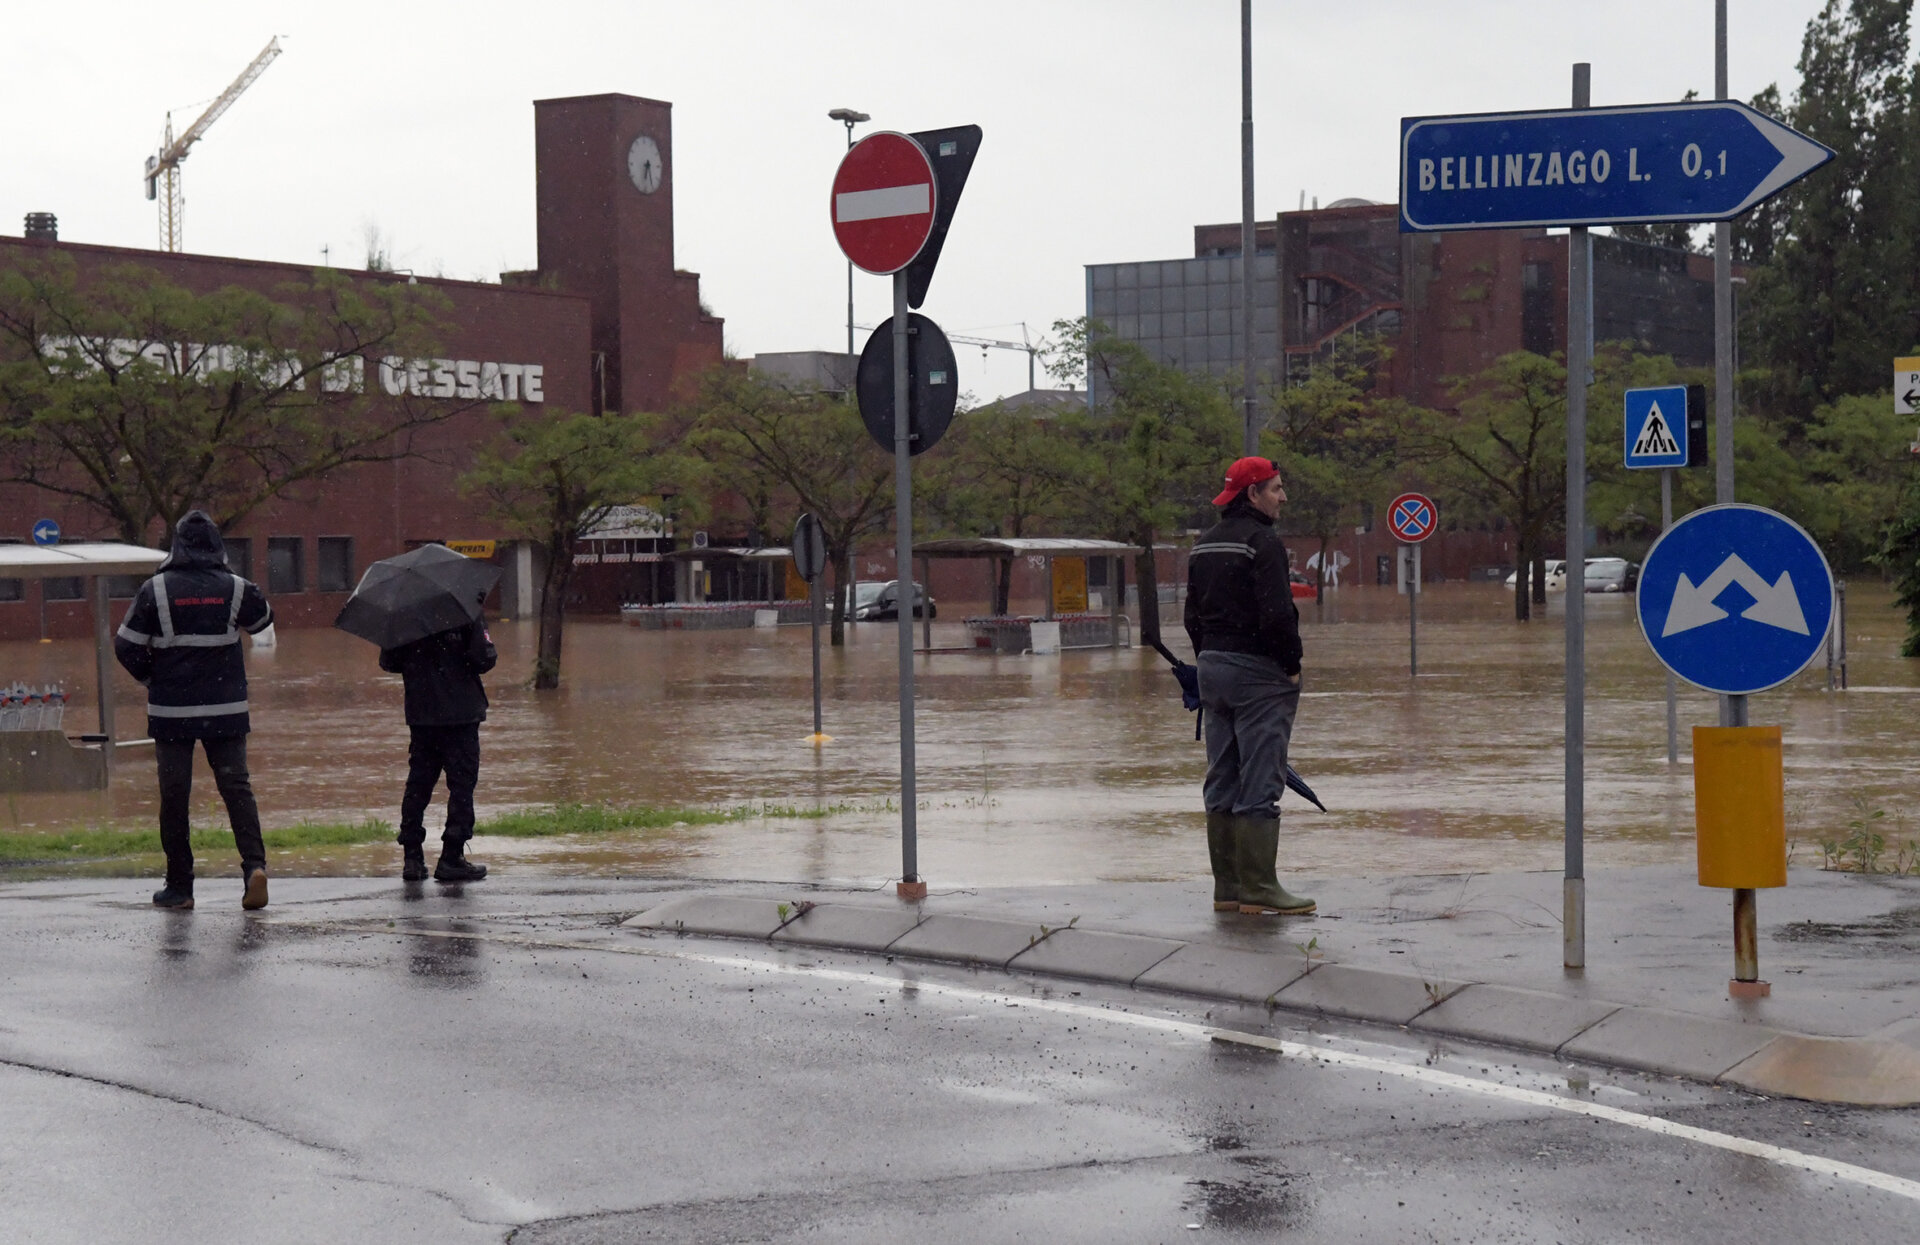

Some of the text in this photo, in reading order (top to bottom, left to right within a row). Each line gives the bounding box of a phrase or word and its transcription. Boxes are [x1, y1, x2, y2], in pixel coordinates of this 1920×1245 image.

[1419, 142, 1728, 192] BELLINZAGO L. 0,1
[379, 355, 545, 402] GESSATE
